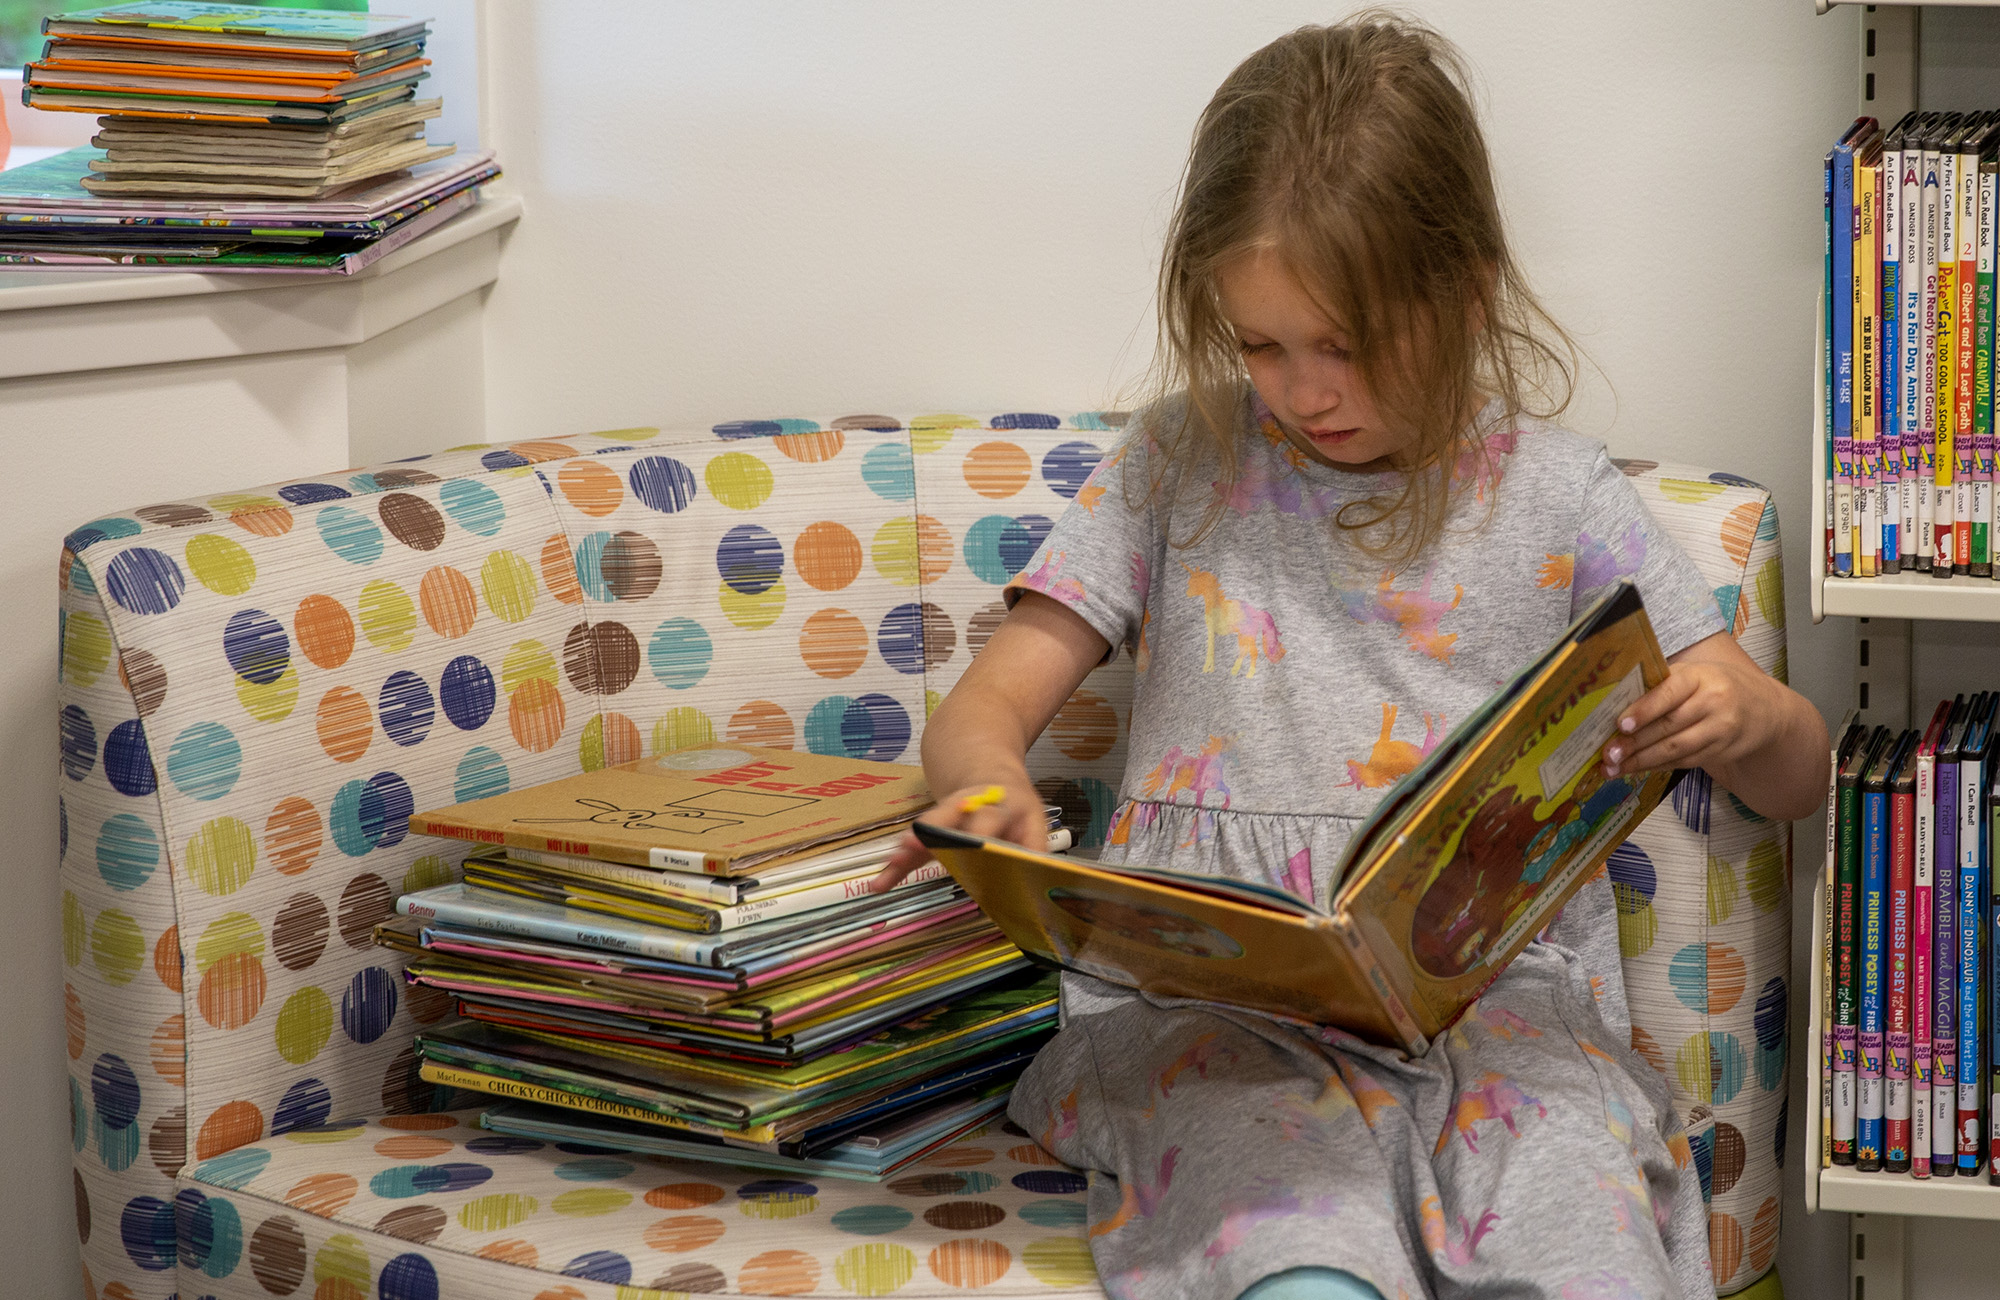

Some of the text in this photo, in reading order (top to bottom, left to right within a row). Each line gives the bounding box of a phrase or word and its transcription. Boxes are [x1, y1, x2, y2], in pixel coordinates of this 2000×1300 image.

[1887, 156, 1894, 168] An
[1944, 155, 1952, 167] My
[1944, 194, 1952, 208] Can
[1965, 179, 1973, 217] Can Read!
[1980, 173, 1991, 247] An Can Read Book
[1887, 243, 1892, 256] 1
[1963, 242, 1972, 255] 2
[1885, 265, 1896, 288] DIRK
[1982, 259, 1988, 270] 3
[1939, 267, 1953, 299] Pete
[1884, 291, 1895, 322] BONES
[1908, 292, 1918, 308] It's
[1942, 299, 1950, 310] the
[1908, 322, 1918, 345] Fair
[1976, 285, 1990, 406] Rafi and Rosi CARNIVAL!
[1905, 348, 1918, 373] Day,
[1924, 275, 1937, 428] Get Ready for Second Grade
[1940, 343, 1948, 362] TOO
[1959, 282, 1973, 430] Gilbert and the Lost Tooth
[1840, 352, 1852, 403] Big Egg
[1863, 316, 1871, 417] THE BIG BALLOON RACE
[1885, 354, 1893, 385] Mystery
[1939, 365, 1948, 391] COOL
[1885, 397, 1893, 408] the
[1907, 376, 1917, 417] Amber
[1939, 409, 1947, 445] SCHOOL
[694, 761, 903, 798] NOT A BOX
[1942, 771, 1952, 836] Haas Friend
[426, 822, 505, 844] ANTOINETTE PORTIS
[1843, 789, 1853, 871] Greene Roth Sisson
[1870, 796, 1880, 879] Greene Roth Sisson
[1897, 796, 1906, 879] Greene Roth Sisson
[546, 839, 590, 856] NOT A BOX
[1967, 851, 1972, 863] 1
[568, 857, 655, 887] BRIMSBY'S HATS
[670, 857, 690, 867] Portis
[1497, 919, 1528, 951] Stan
[1544, 877, 1566, 902] Jan
[1566, 806, 1633, 877] Berenstain
[1964, 875, 1975, 915] DANNY
[408, 902, 437, 918] Benny
[737, 912, 763, 925] LEWIN
[1895, 890, 1906, 949] PRINCESS
[577, 932, 627, 948] Kane/Miller
[1840, 883, 1852, 986] PRINCESS POSEY
[1866, 891, 1880, 995] PRINCESS POSEY
[1938, 869, 1953, 1037] BRAMBLE and MAGGIE
[1963, 929, 1974, 983] DINOSAUR
[1894, 953, 1905, 994] POSEY
[1964, 985, 1973, 1001] and
[1964, 1004, 1973, 1018] the
[1964, 1020, 1973, 1037] Girl
[1963, 1039, 1973, 1058] Next
[436, 1071, 481, 1087] MacLennan
[1963, 1061, 1973, 1081] Door
[488, 1080, 680, 1125] CHICKY CHICKY CHOOK CHOOK
